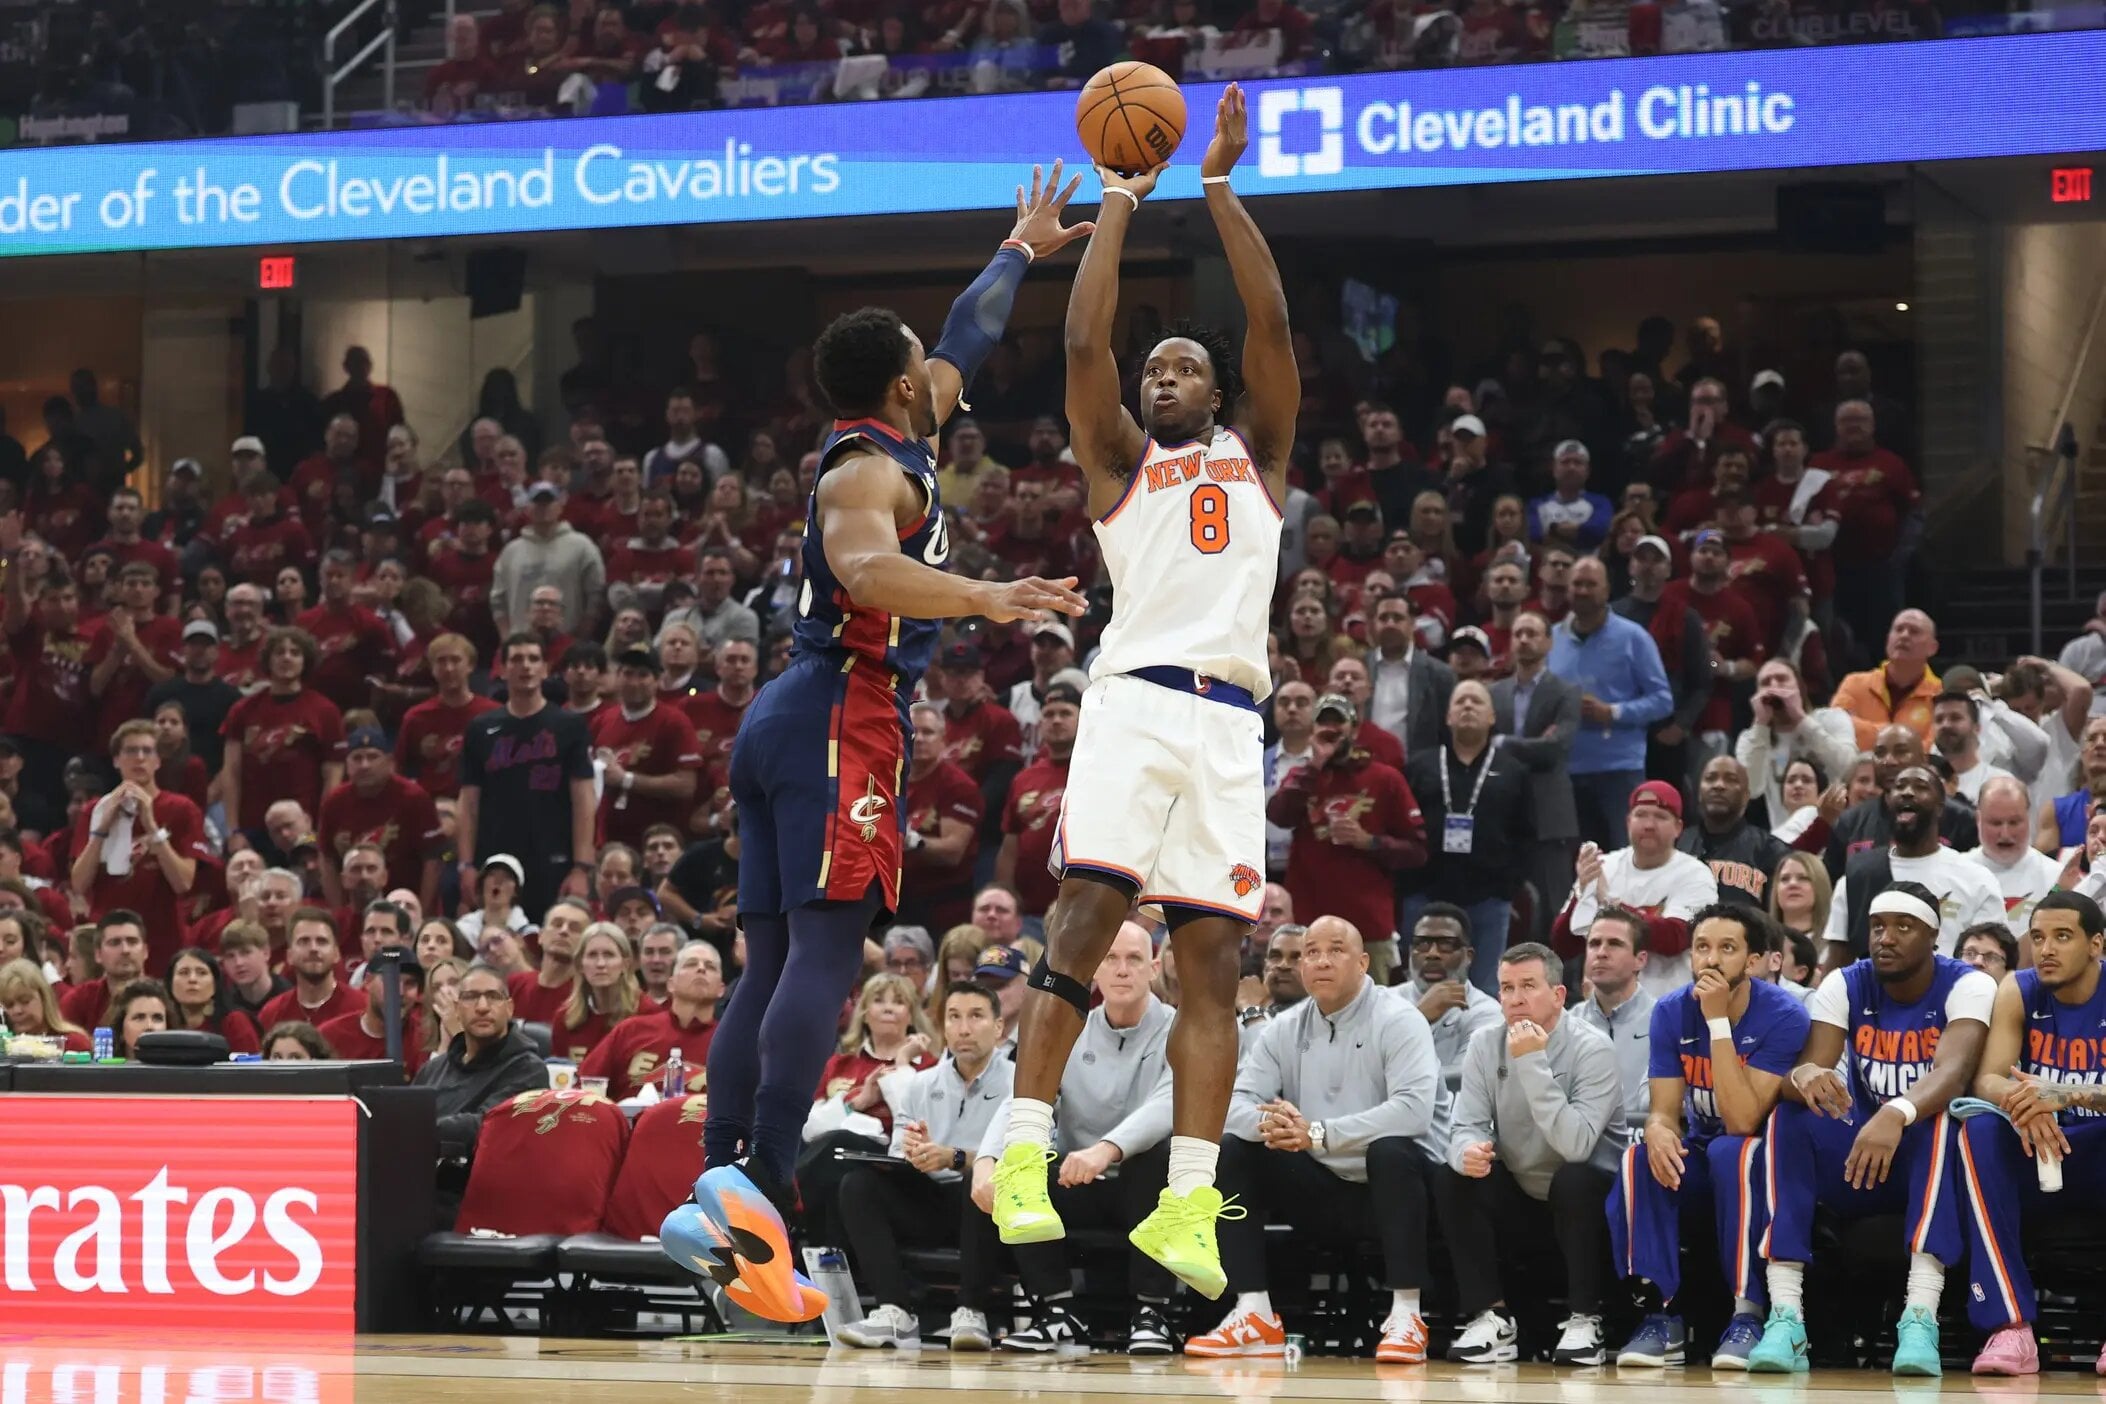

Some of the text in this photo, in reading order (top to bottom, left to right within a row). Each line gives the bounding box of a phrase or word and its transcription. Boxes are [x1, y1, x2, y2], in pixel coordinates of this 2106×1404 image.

[1356, 79, 1796, 155] Cleveland Clinic
[0, 136, 841, 234] der of the Cleveland Cavaliers
[1144, 452, 1258, 494] NEW ORK
[1190, 484, 1230, 555] 8
[1708, 860, 1768, 899] YORK
[0, 1164, 323, 1297] rates
